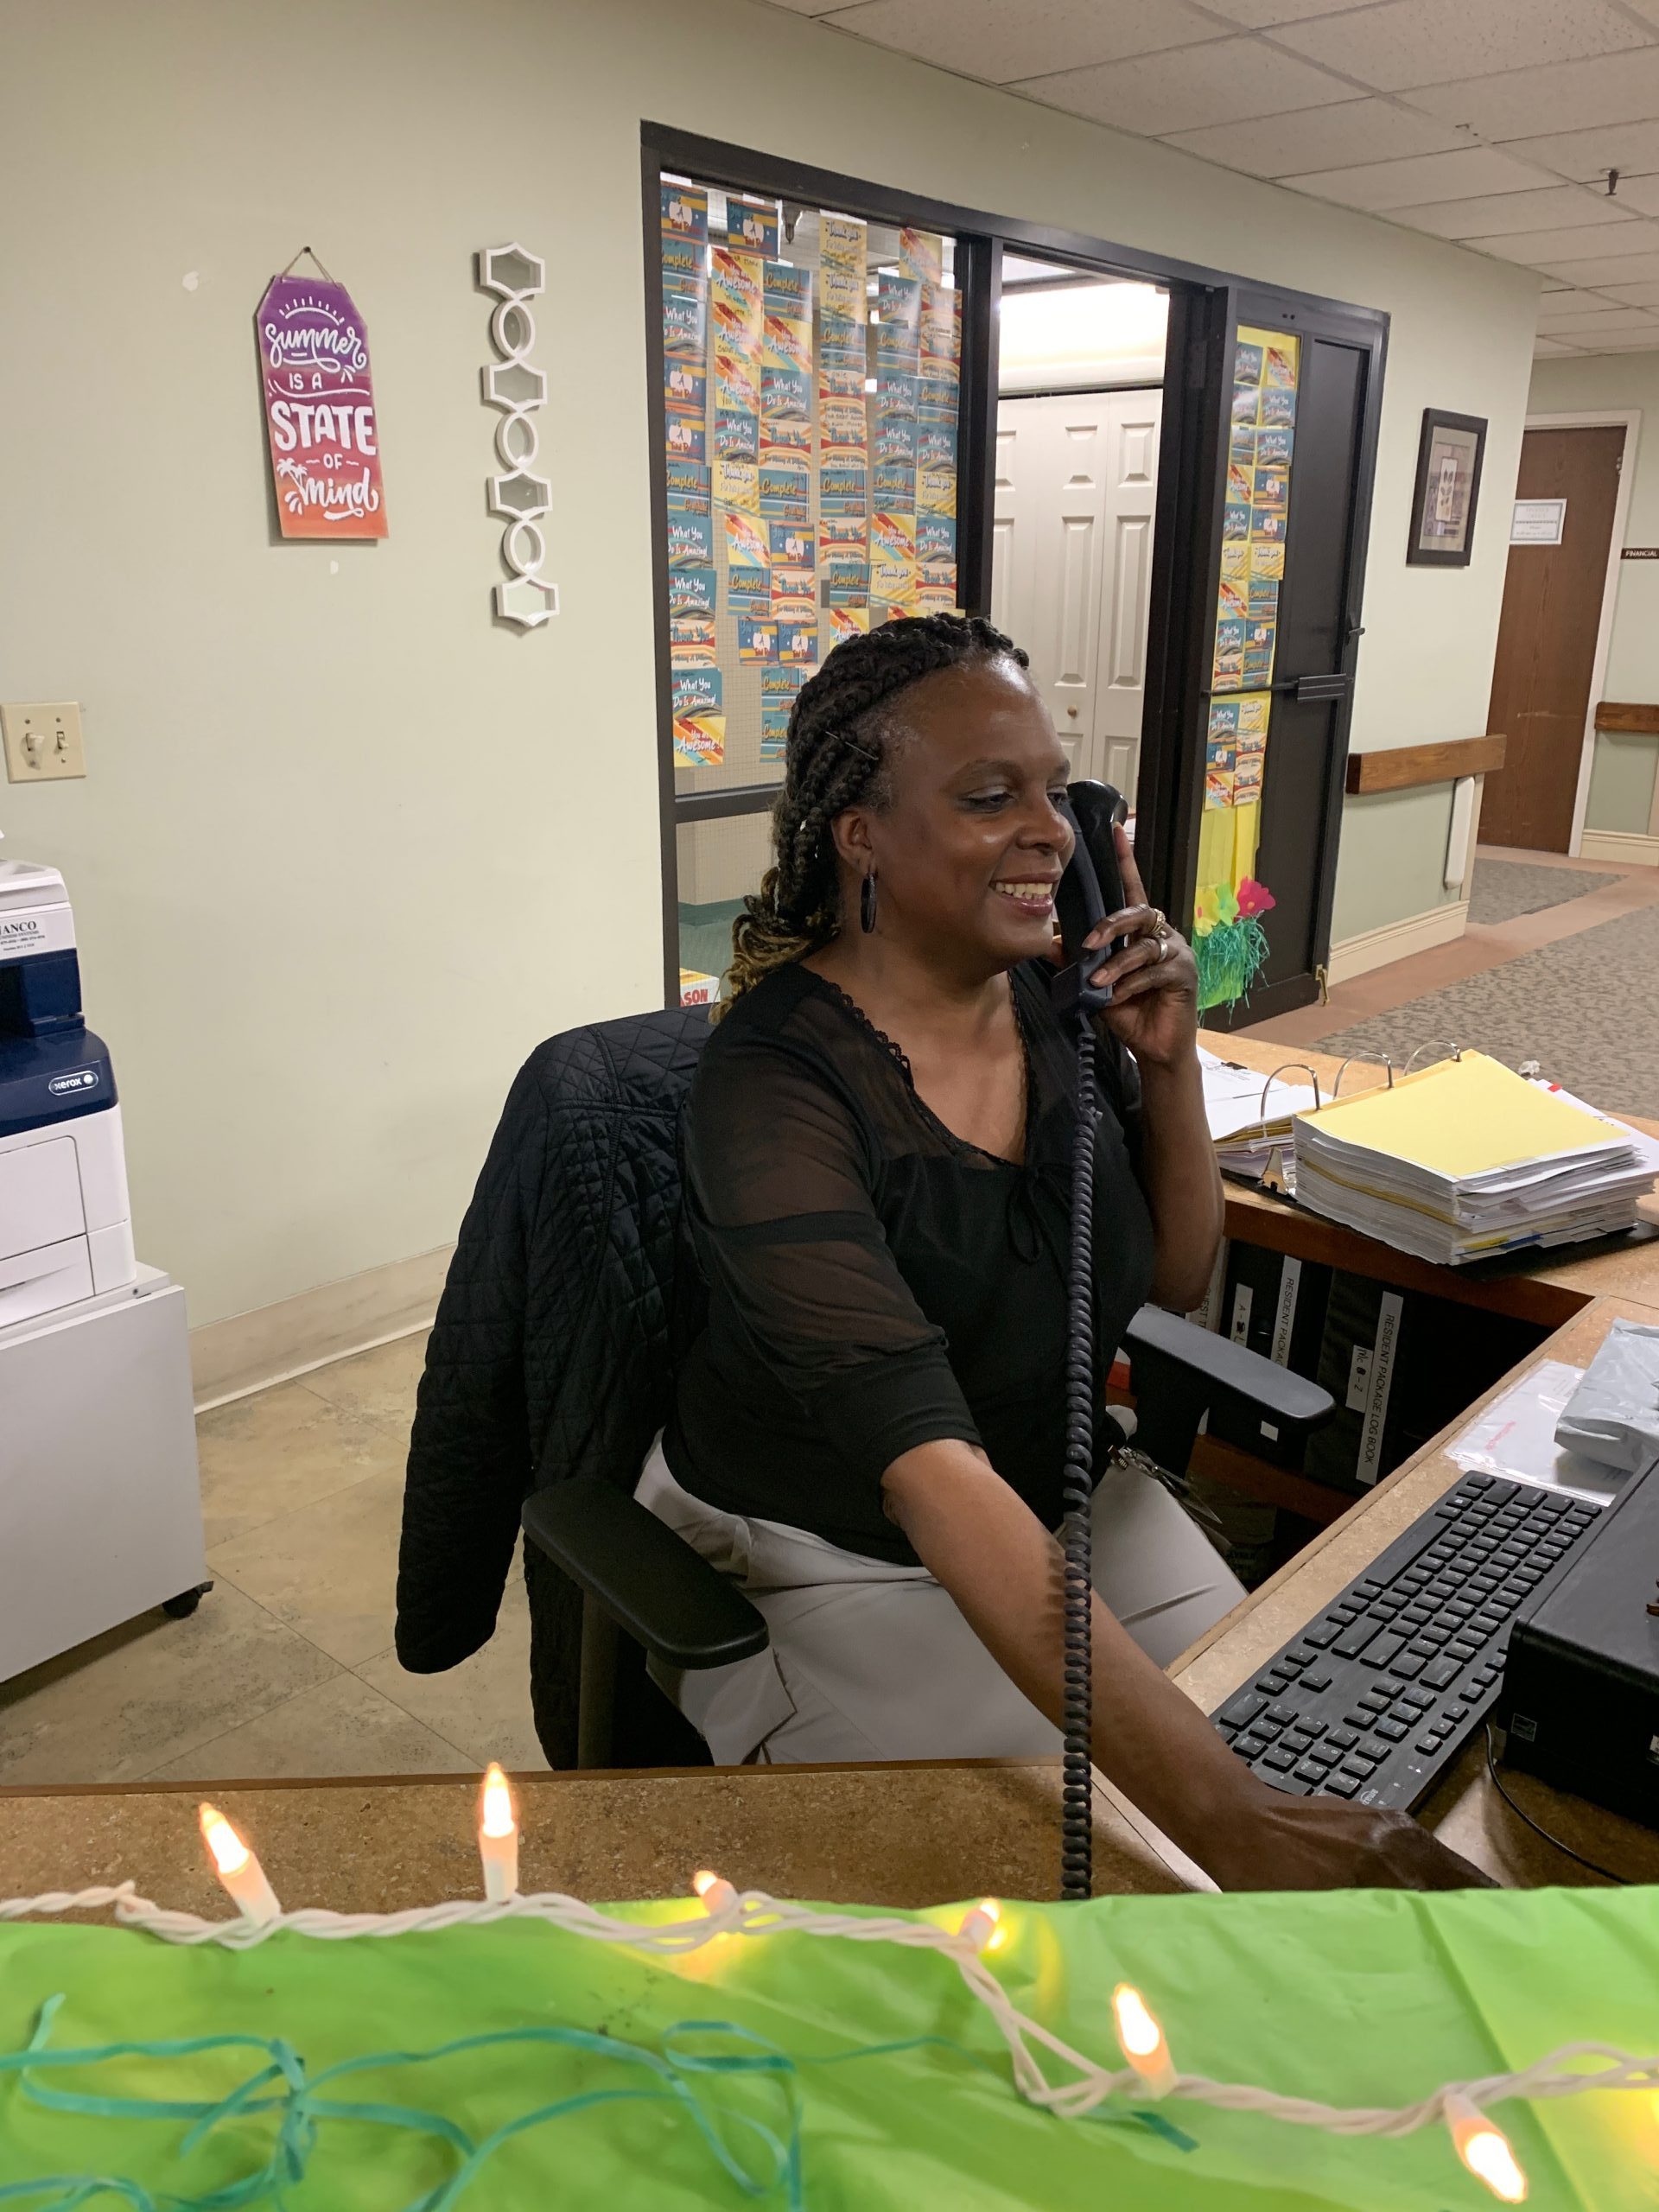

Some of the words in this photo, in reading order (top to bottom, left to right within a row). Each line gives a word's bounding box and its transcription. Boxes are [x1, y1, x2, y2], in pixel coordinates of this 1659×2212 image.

[662, 251, 694, 270] omplete
[265, 323, 367, 373] Summer
[289, 373, 304, 390] IS
[312, 372, 323, 390] A
[773, 378, 791, 391] What
[791, 379, 803, 394] You
[887, 381, 902, 395] What
[903, 383, 912, 397] You
[766, 393, 776, 405] Do
[777, 395, 782, 405] Is
[270, 400, 377, 455] STATE
[727, 418, 742, 432] What
[743, 422, 753, 435] You
[886, 427, 901, 441] What
[902, 429, 912, 442] You
[720, 435, 728, 447] Do
[729, 435, 734, 445] Is
[768, 427, 791, 443] Thank
[793, 428, 806, 447] You
[323, 454, 343, 470] OF
[762, 477, 798, 498] Complete
[823, 476, 855, 496] Complete
[876, 474, 906, 492] Complete
[672, 525, 690, 538] What
[691, 526, 703, 541] You
[828, 524, 849, 540] Thank
[925, 525, 940, 538] What
[941, 525, 950, 539] You
[674, 576, 693, 590] What
[694, 577, 706, 592] You
[731, 573, 762, 593] Complete
[779, 579, 799, 594] Thank
[800, 580, 812, 596] You
[833, 572, 860, 588] Complete
[680, 679, 698, 692] What
[699, 677, 711, 692] You
[763, 677, 791, 693] Complete
[672, 696, 683, 709] Do
[683, 696, 690, 708] Is
[690, 693, 716, 707] Amazing!
[762, 723, 788, 741] Complet
[677, 734, 721, 754] Awesome!
[0, 920, 36, 934] ANCO
[54, 1077, 83, 1090] xerox
[1281, 1277, 1294, 1328] RESIDENT
[1381, 1313, 1395, 1365] RESIDENT
[1371, 1366, 1387, 1414] PACKAGE
[1369, 1414, 1380, 1435] LOG
[1364, 1435, 1377, 1465] BOOK
